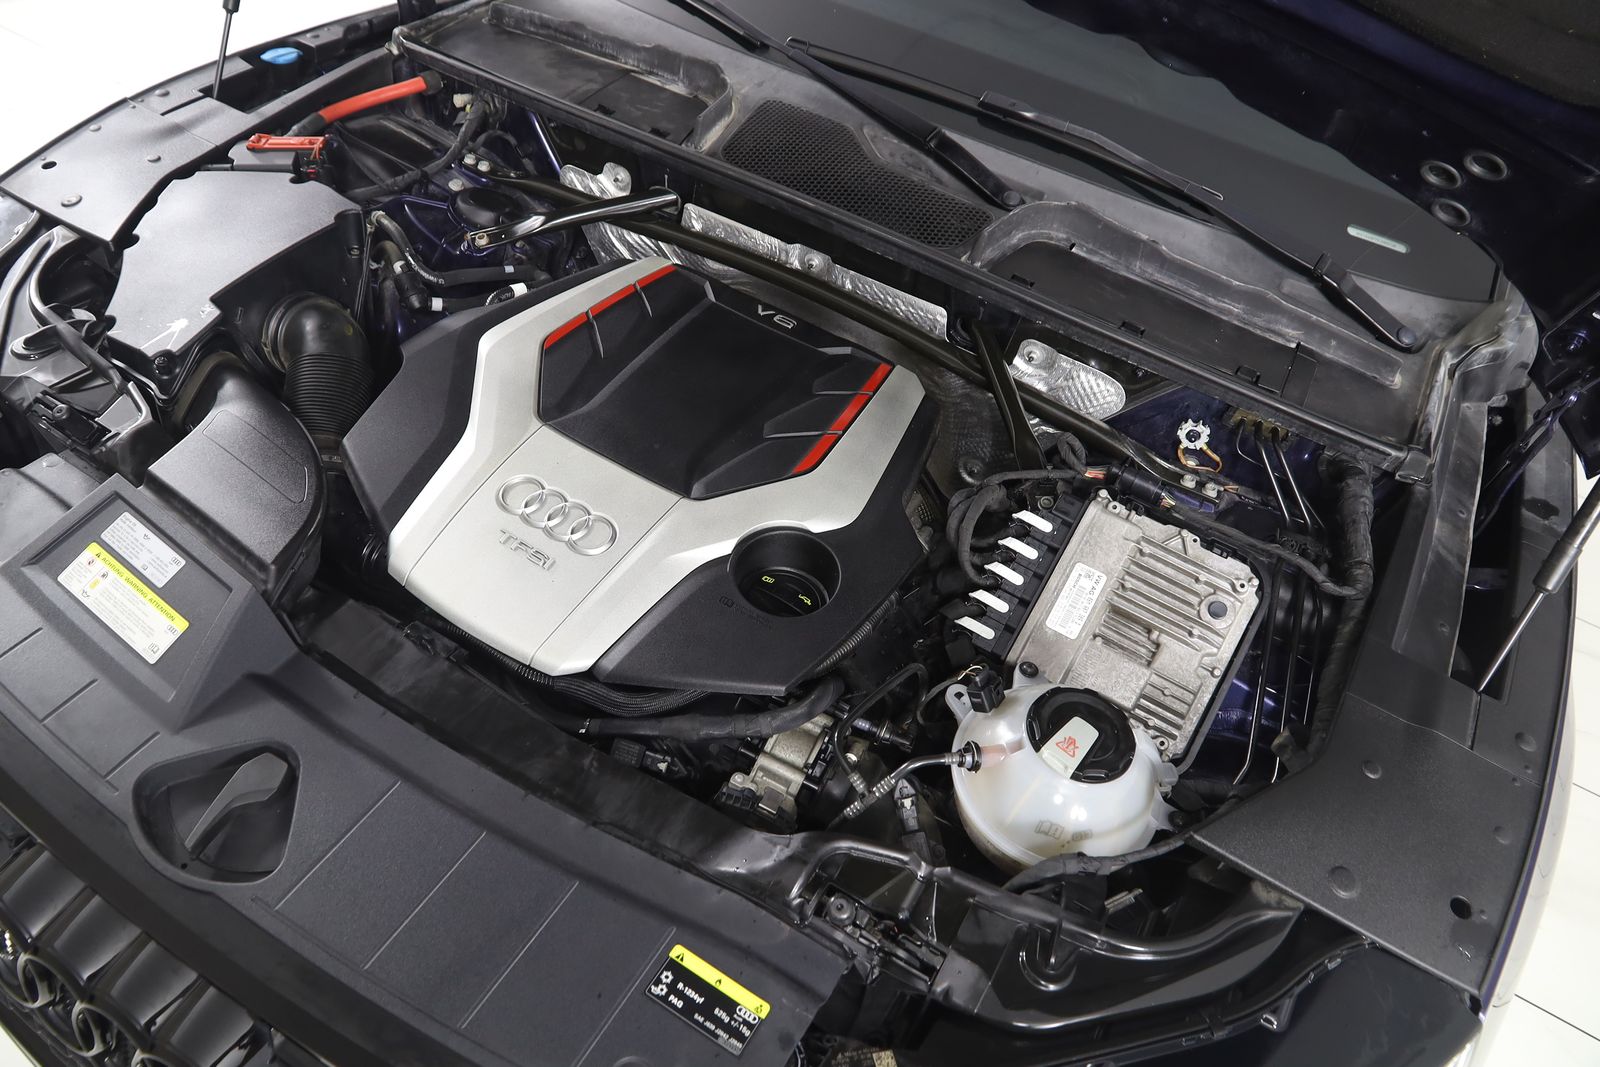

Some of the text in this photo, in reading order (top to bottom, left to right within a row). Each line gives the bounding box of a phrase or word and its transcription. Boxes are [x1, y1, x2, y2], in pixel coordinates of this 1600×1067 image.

[757, 303, 798, 329] V6
[499, 529, 556, 571] TFSI
[101, 556, 176, 622] ACHTUNG WARNING ATTENTION
[668, 994, 684, 1009] PAG
[676, 981, 705, 1004] R-1234yf
